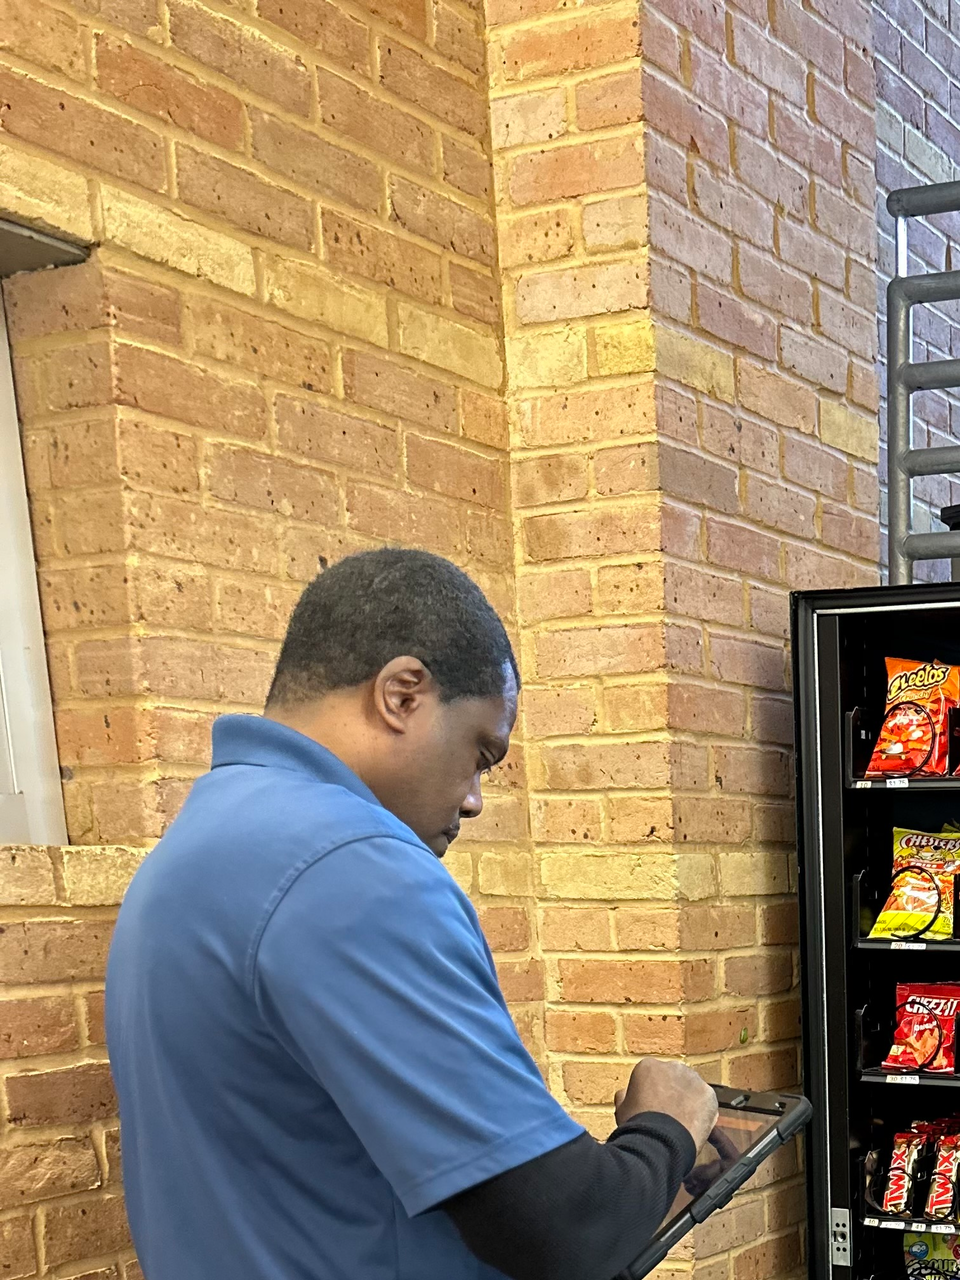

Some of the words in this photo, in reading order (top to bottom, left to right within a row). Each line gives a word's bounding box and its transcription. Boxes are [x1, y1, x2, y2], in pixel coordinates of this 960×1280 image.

[886, 663, 950, 702] Cheetos
[882, 1148, 908, 1211] TWIX
[927, 1149, 957, 1216] TWIX
